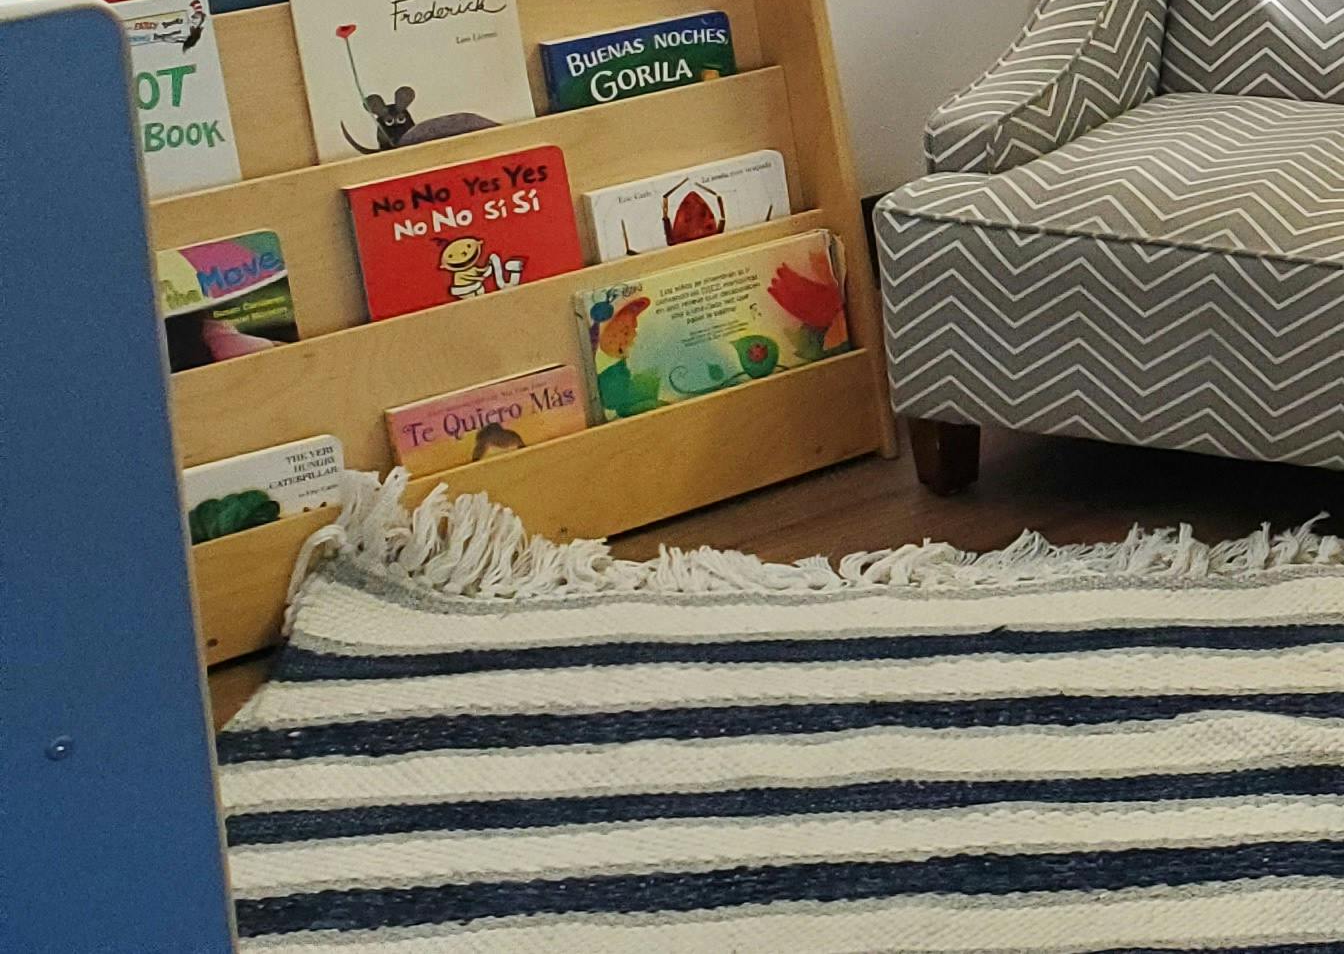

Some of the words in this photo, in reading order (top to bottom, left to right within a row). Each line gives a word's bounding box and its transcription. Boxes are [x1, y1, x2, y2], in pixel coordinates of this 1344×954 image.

[566, 37, 645, 78] BUENAS
[590, 58, 694, 102] GORILA
[144, 119, 226, 153] BOOK
[372, 197, 406, 218] No
[411, 183, 451, 209] No
[464, 176, 500, 196] Yes
[503, 164, 548, 187] Yes
[393, 219, 428, 242] No
[432, 206, 473, 233] No
[484, 198, 508, 220] Sí
[511, 188, 541, 214] Sí
[402, 422, 434, 447] Te
[443, 403, 523, 441] Quiero
[529, 384, 576, 414] Más
